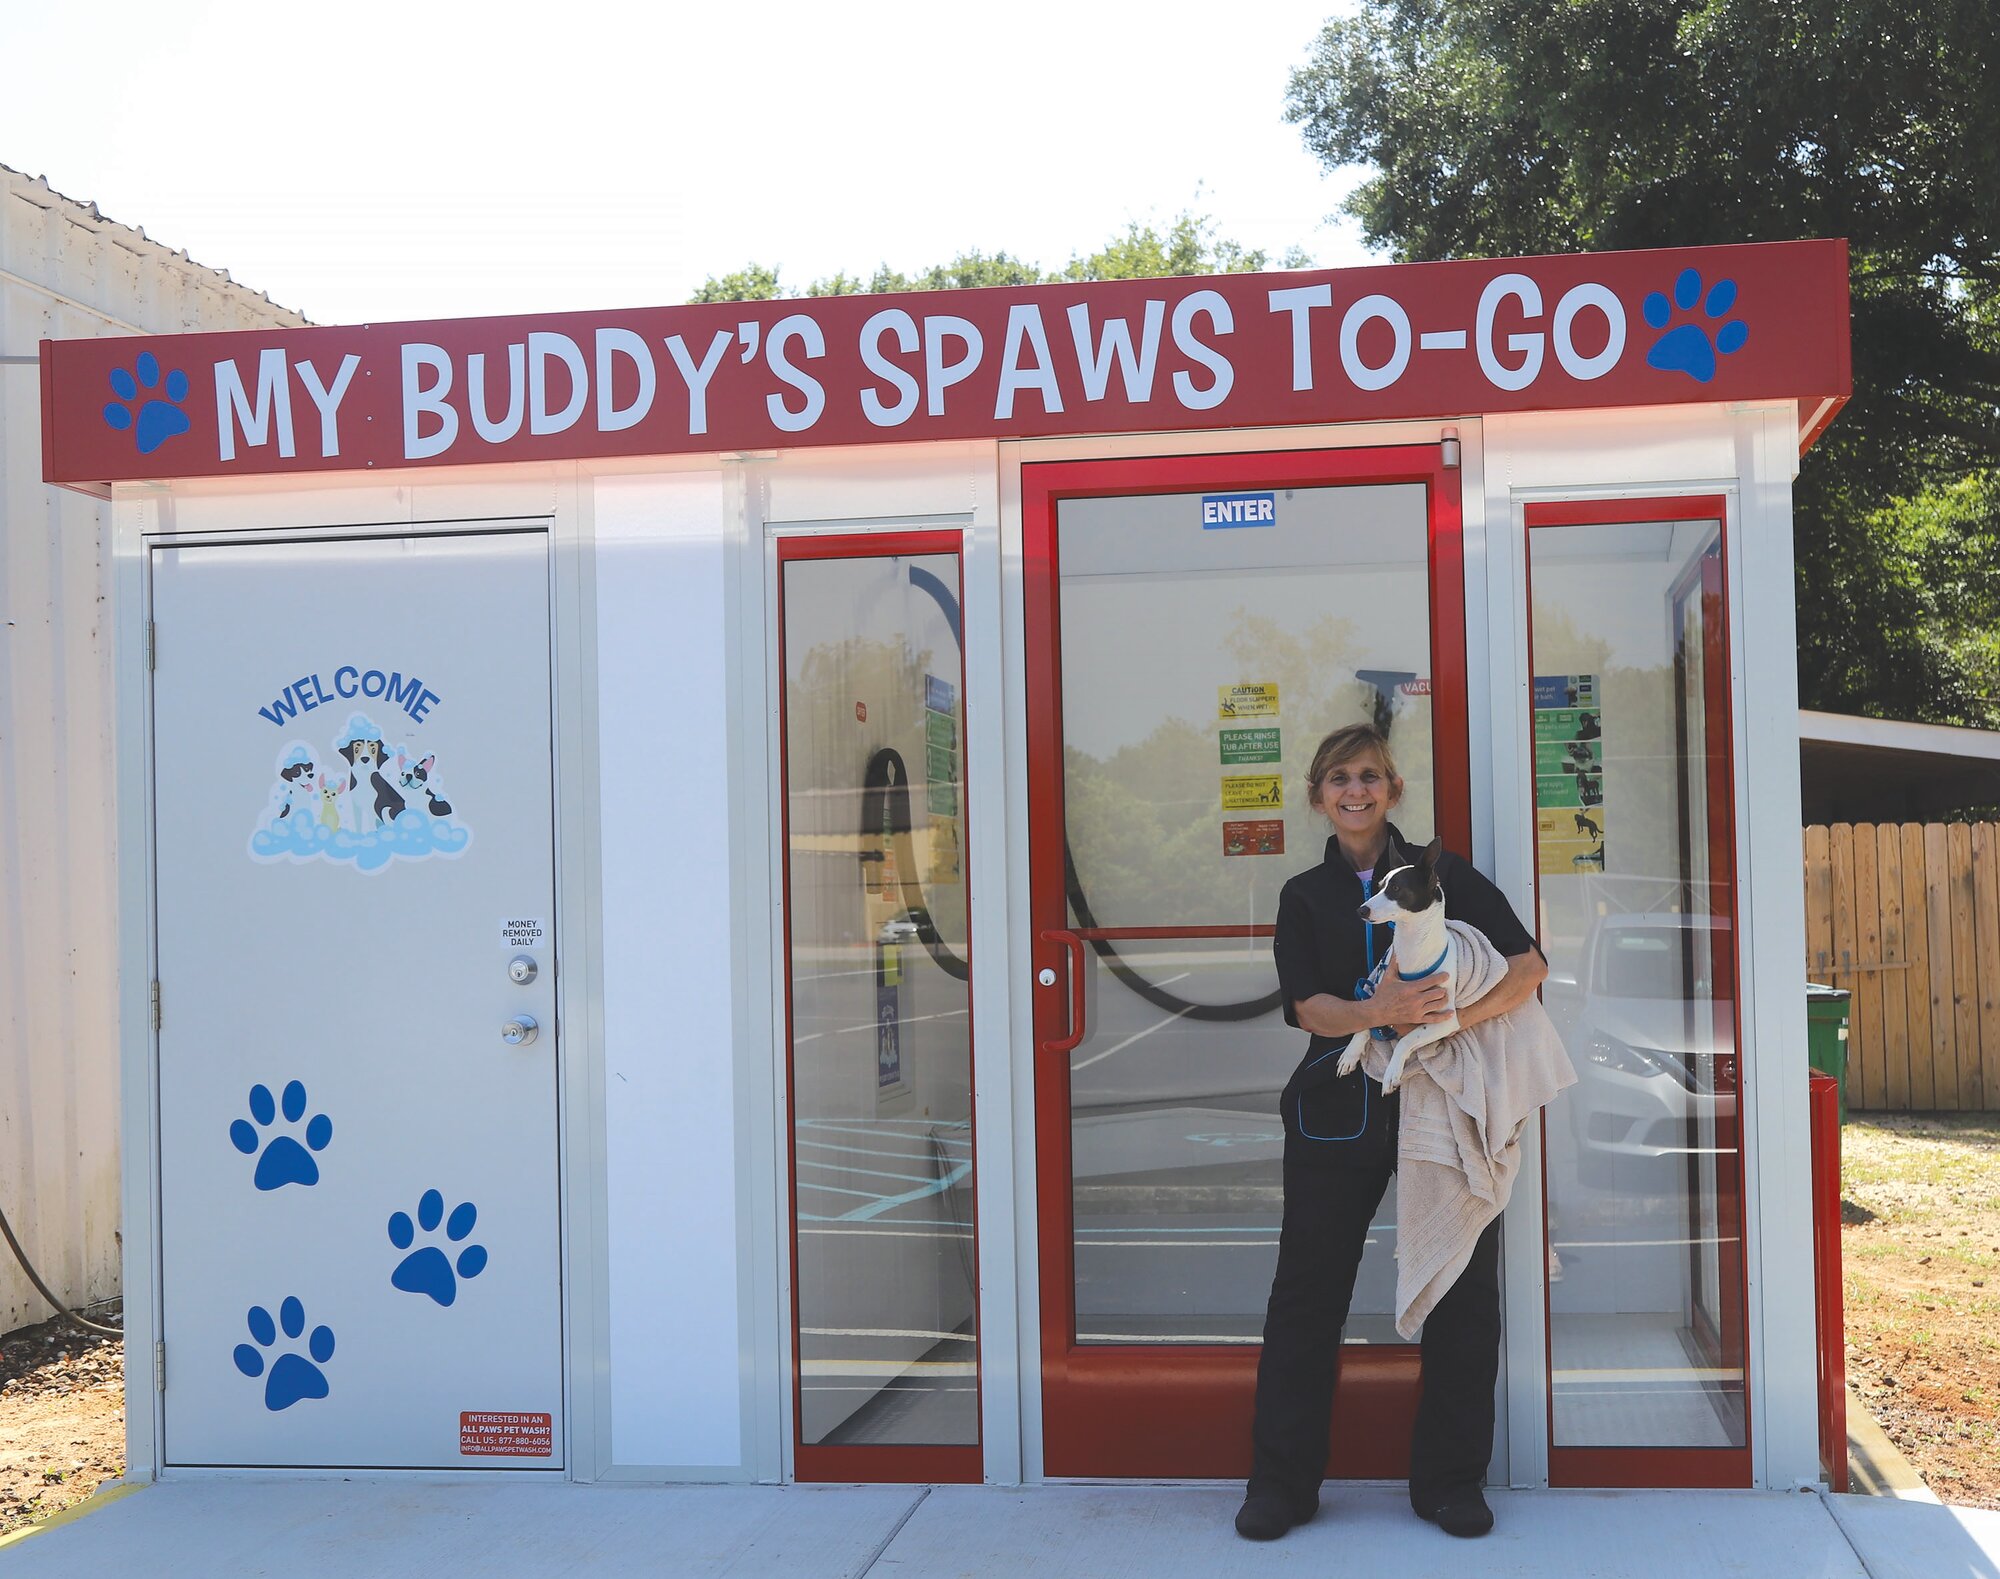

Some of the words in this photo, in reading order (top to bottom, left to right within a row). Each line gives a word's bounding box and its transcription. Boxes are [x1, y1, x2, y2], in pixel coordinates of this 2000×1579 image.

[213, 348, 362, 463] MY
[401, 314, 827, 460] BUDDY'S
[858, 289, 1235, 427] SPAWS
[1267, 273, 1627, 392] TO-GO
[1203, 499, 1274, 524] ENTER
[1231, 686, 1265, 694] CAUTION
[258, 665, 441, 728] WELCOME
[1223, 733, 1253, 741] PLEASE
[1254, 731, 1277, 740] RINSE
[1222, 743, 1237, 751] TUB
[1238, 742, 1263, 750] AFTER
[1264, 741, 1279, 749] USE
[507, 920, 537, 928] MONEY
[502, 929, 542, 937] REMOVED
[511, 938, 534, 946] DAILY
[469, 1415, 519, 1424] INTERESTED
[521, 1416, 529, 1424] IN
[531, 1416, 543, 1424] AN
[479, 1426, 503, 1434] PAWS
[504, 1426, 520, 1434] PET
[521, 1426, 551, 1435] WASH?
[461, 1436, 481, 1444] CALL
[483, 1436, 497, 1444] US:
[499, 1437, 550, 1445] 877-880-6056
